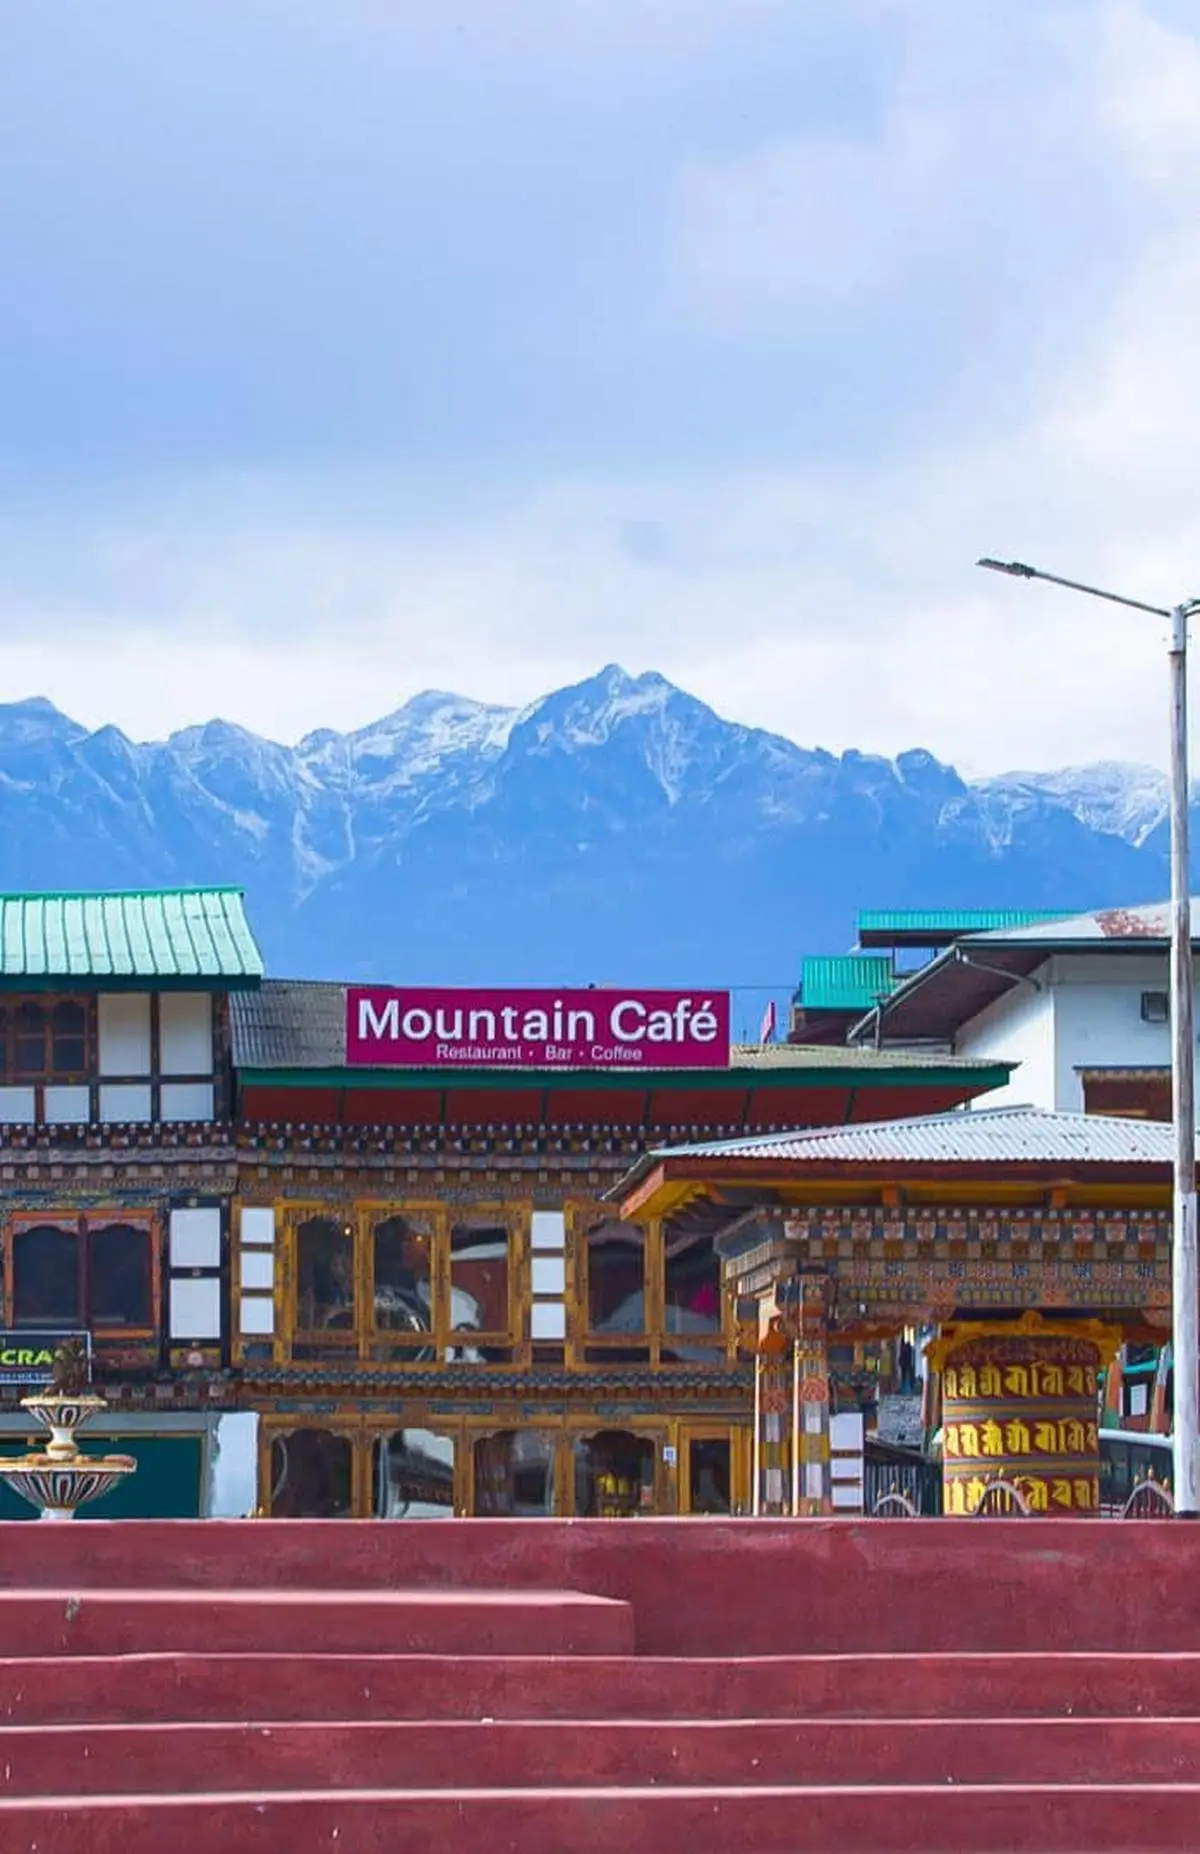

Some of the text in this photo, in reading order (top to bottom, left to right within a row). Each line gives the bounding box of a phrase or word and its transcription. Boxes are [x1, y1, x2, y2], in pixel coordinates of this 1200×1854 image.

[357, 998, 718, 1042] Mountain Café
[436, 1043, 642, 1061] Restaurant Bar Coffee
[0, 1349, 54, 1366] CRA
